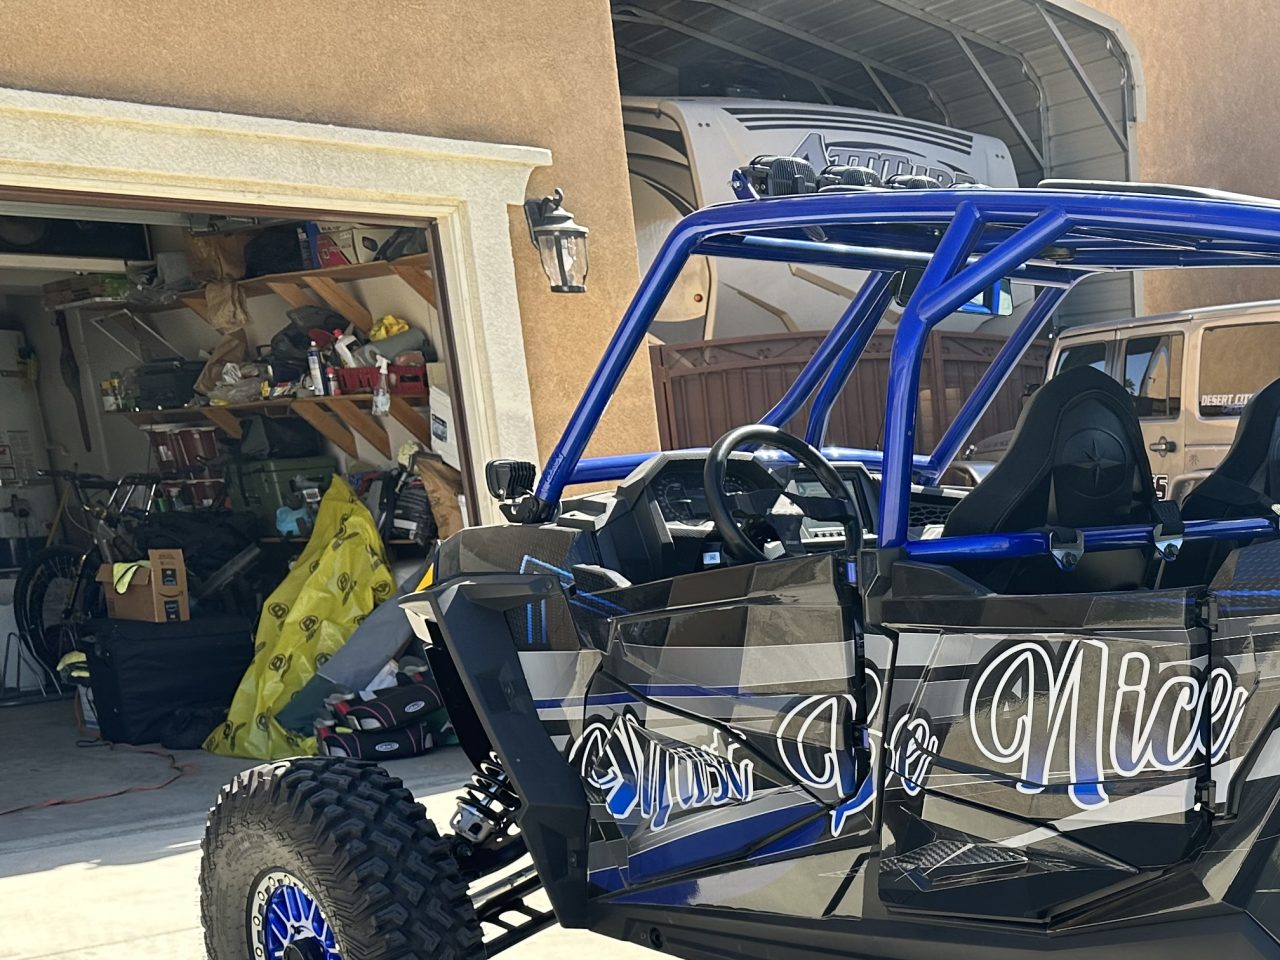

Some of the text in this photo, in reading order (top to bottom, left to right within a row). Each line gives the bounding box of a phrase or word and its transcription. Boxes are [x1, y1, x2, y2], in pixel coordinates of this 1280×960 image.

[1201, 394, 1233, 405] DESERT
[776, 667, 939, 837] Be
[970, 638, 1249, 811] Nice
